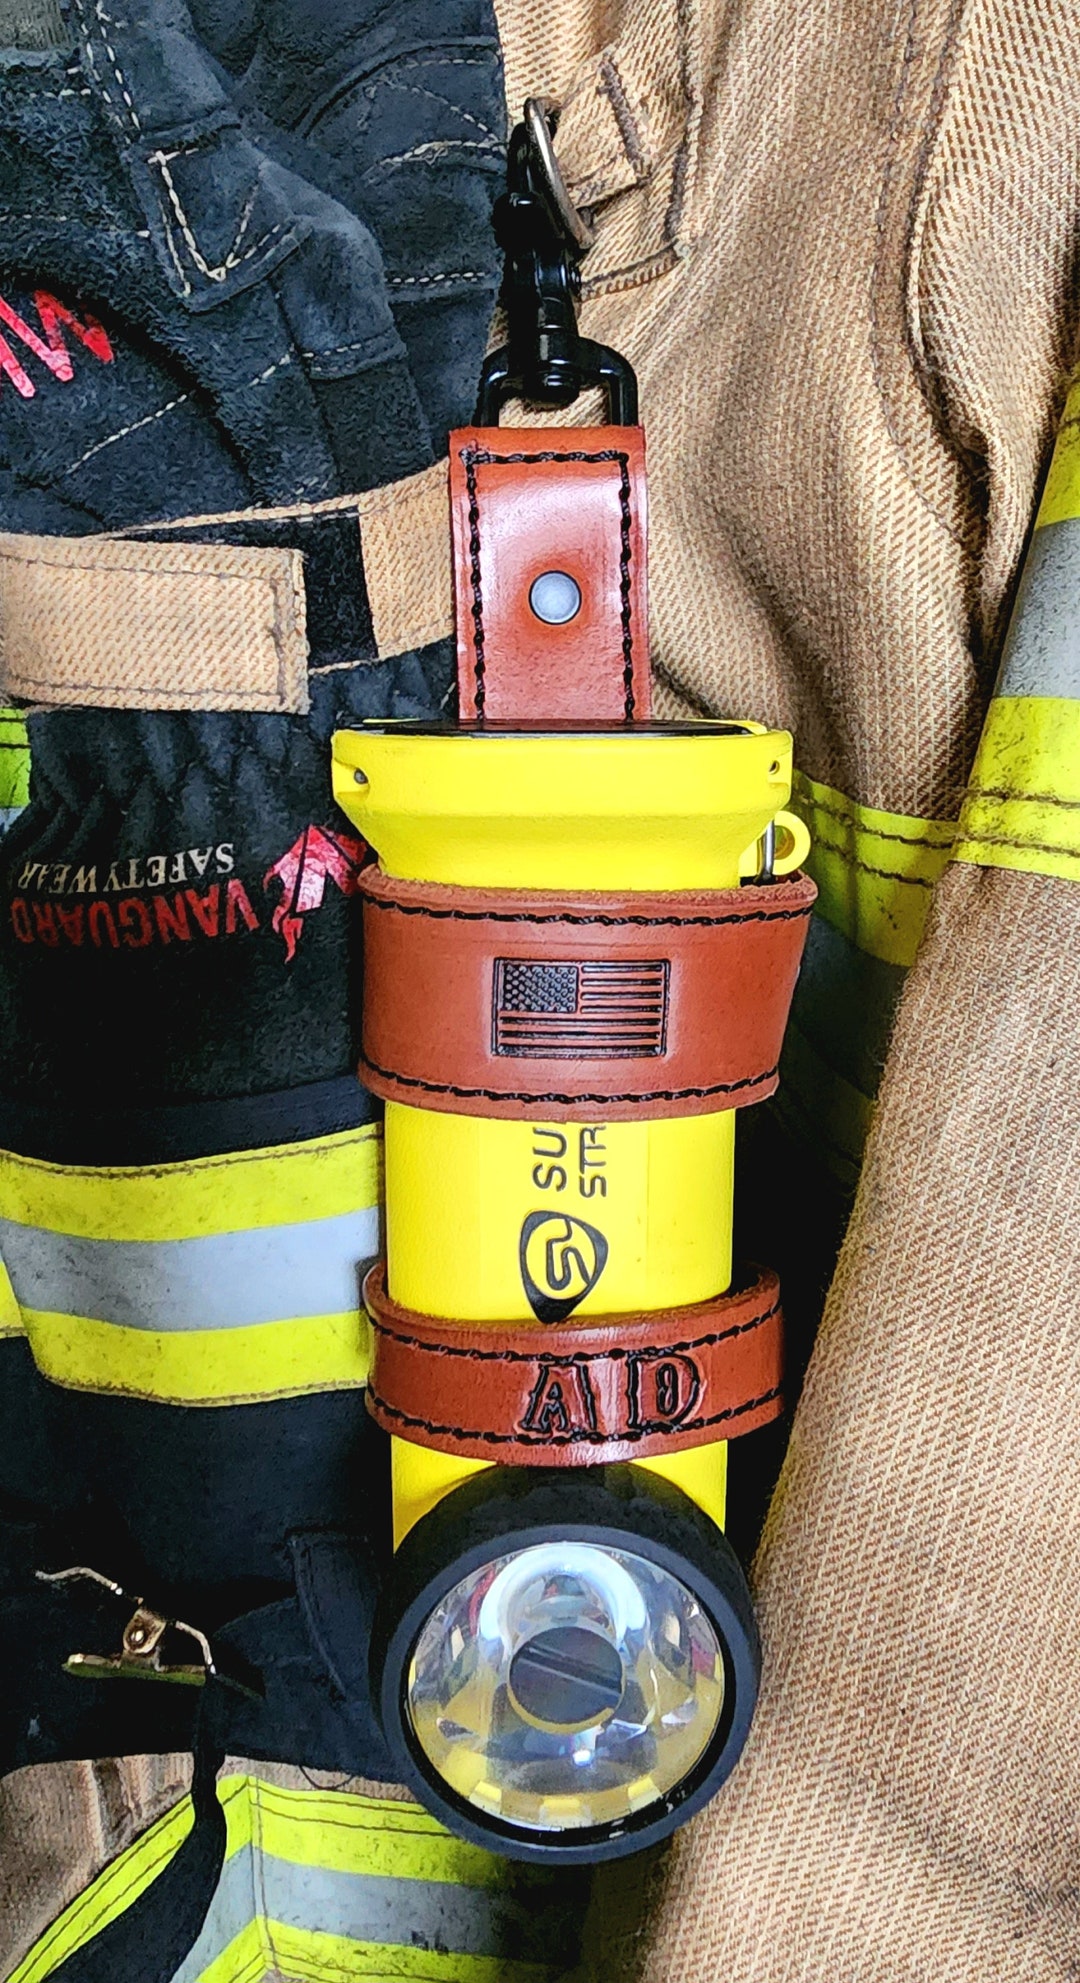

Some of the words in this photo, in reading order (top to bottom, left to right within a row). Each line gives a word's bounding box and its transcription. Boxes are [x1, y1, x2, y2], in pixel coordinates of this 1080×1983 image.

[17, 860, 97, 894] WEAR
[103, 843, 234, 892] SAFETY
[10, 878, 260, 948] VANGUARD
